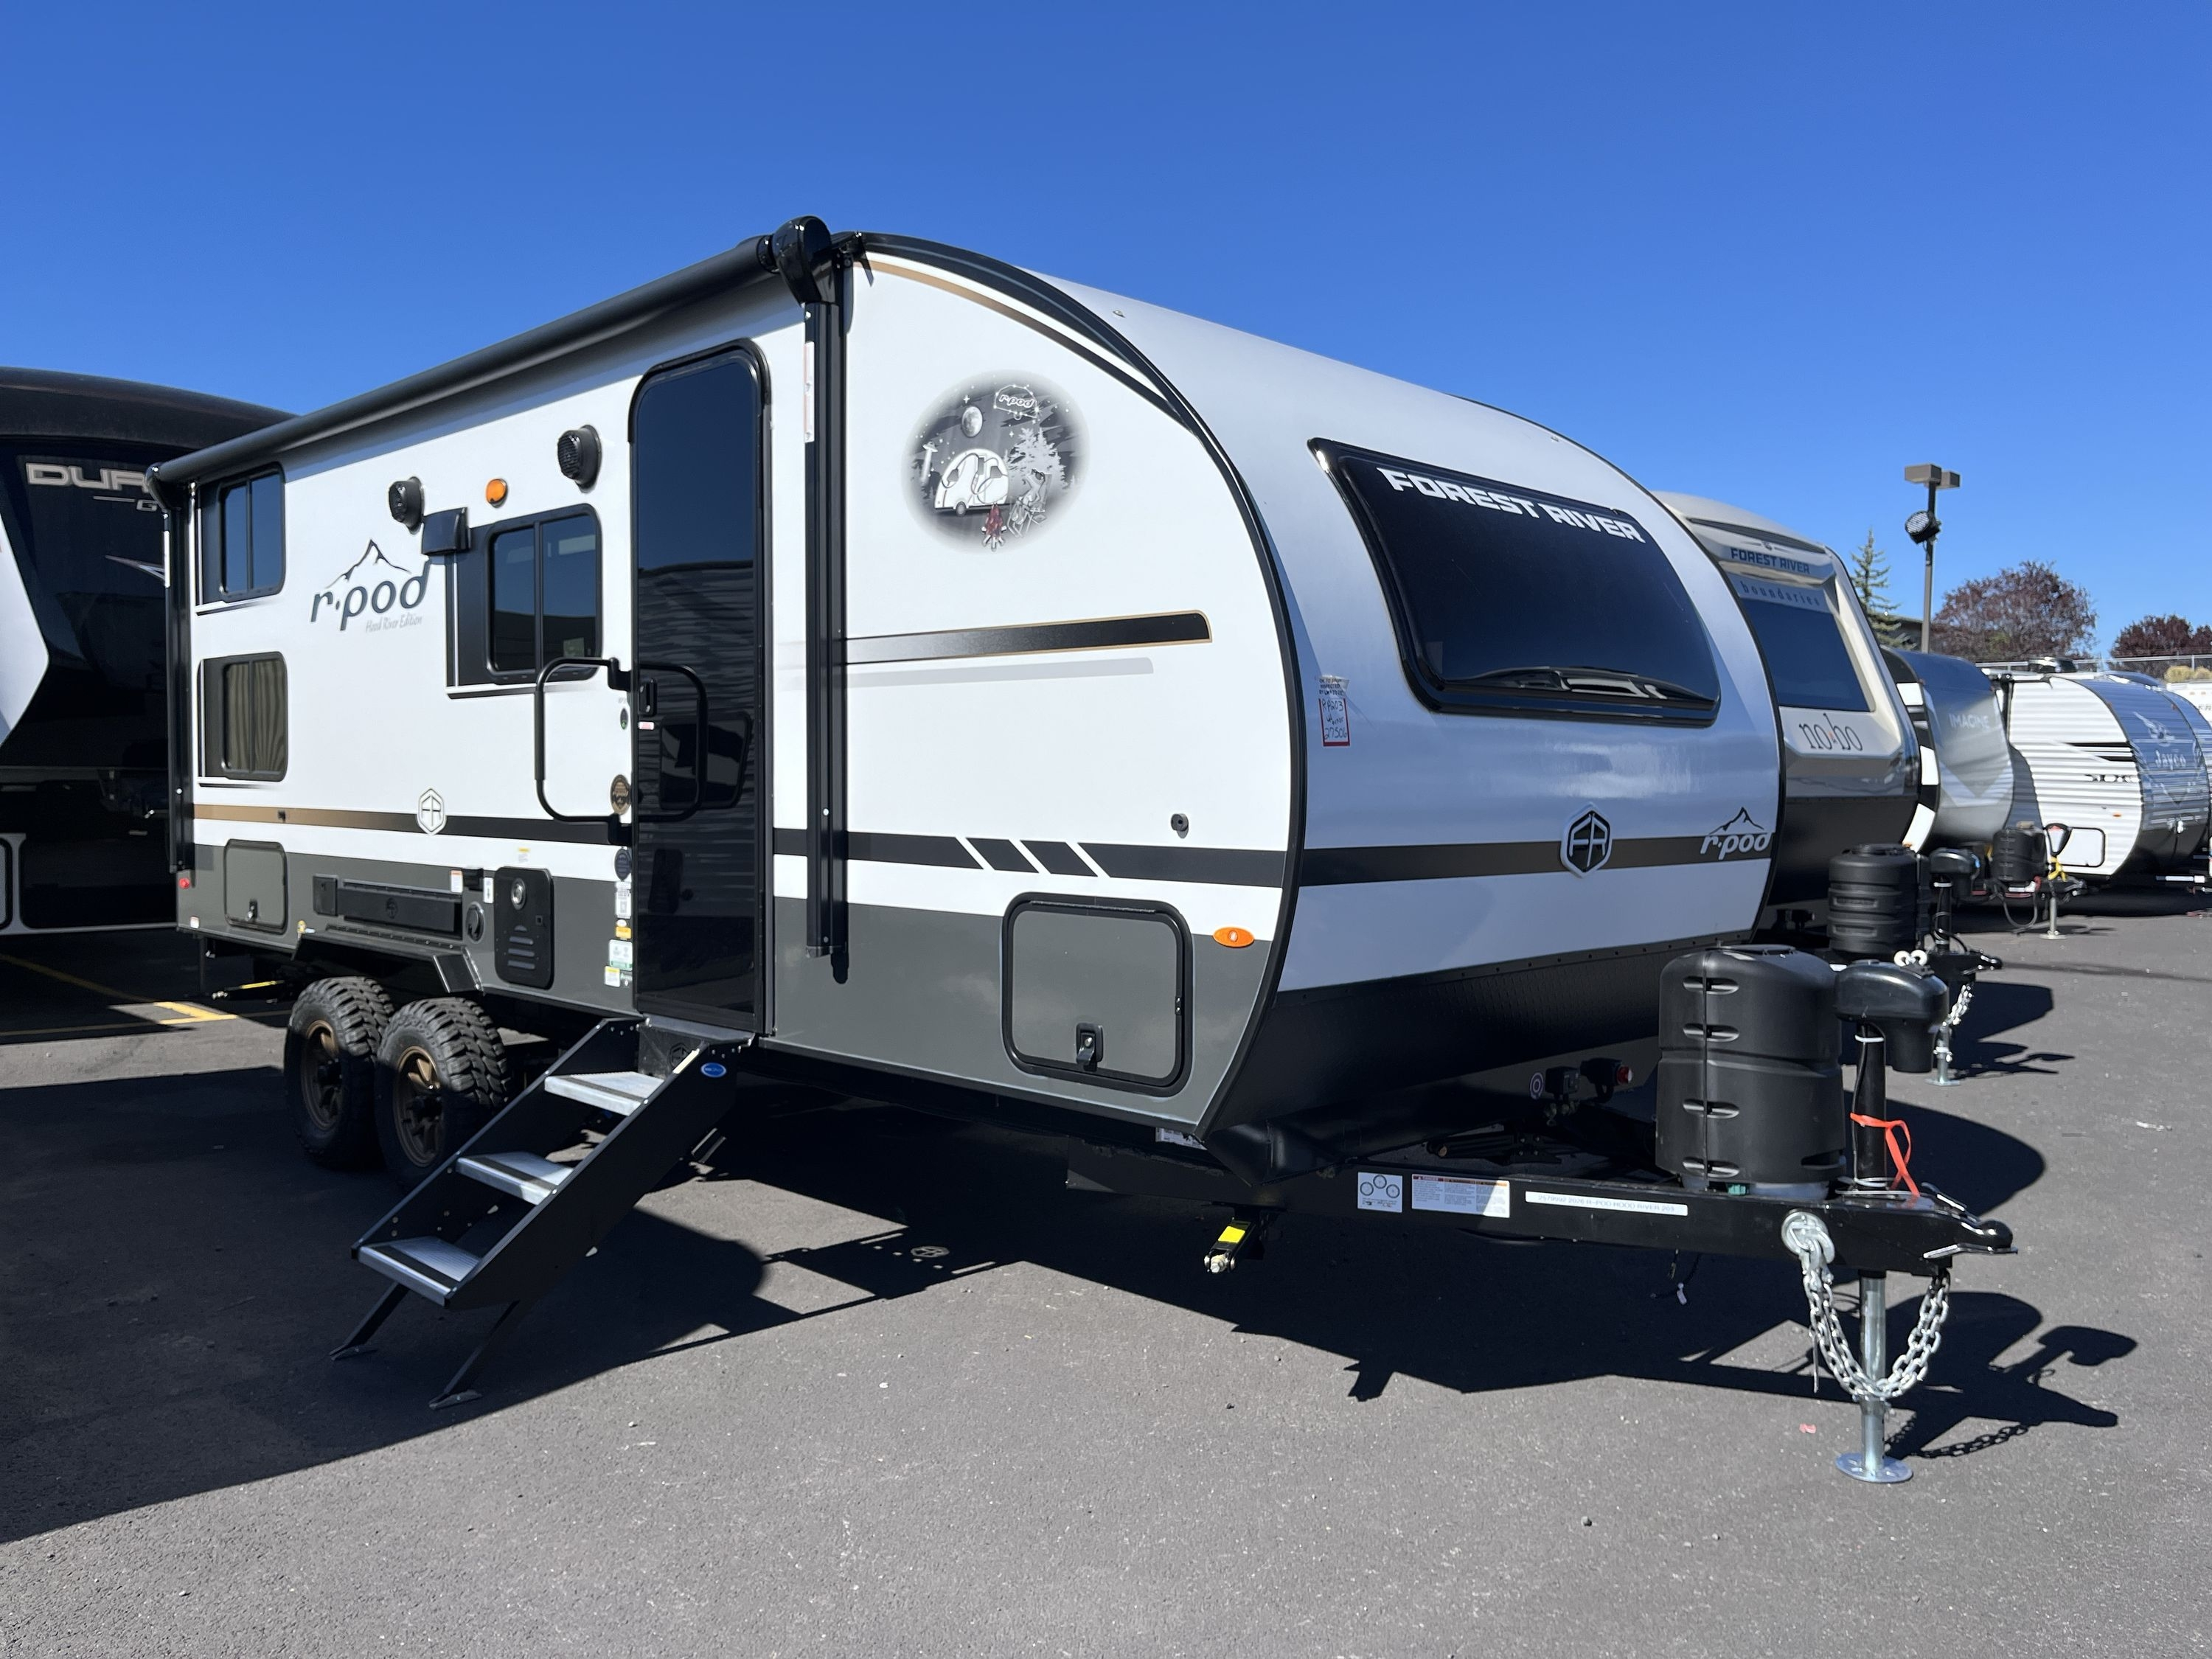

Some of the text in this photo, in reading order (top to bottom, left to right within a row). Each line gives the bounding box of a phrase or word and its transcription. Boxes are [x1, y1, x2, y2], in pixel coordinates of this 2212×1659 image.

[1377, 467, 1646, 543] FOREST RIVER
[1731, 548, 1811, 574] FOREST RIVER
[1740, 581, 1820, 606] boundaries
[366, 612, 422, 633] Hood River Edition
[2154, 750, 2187, 771] Jayco
